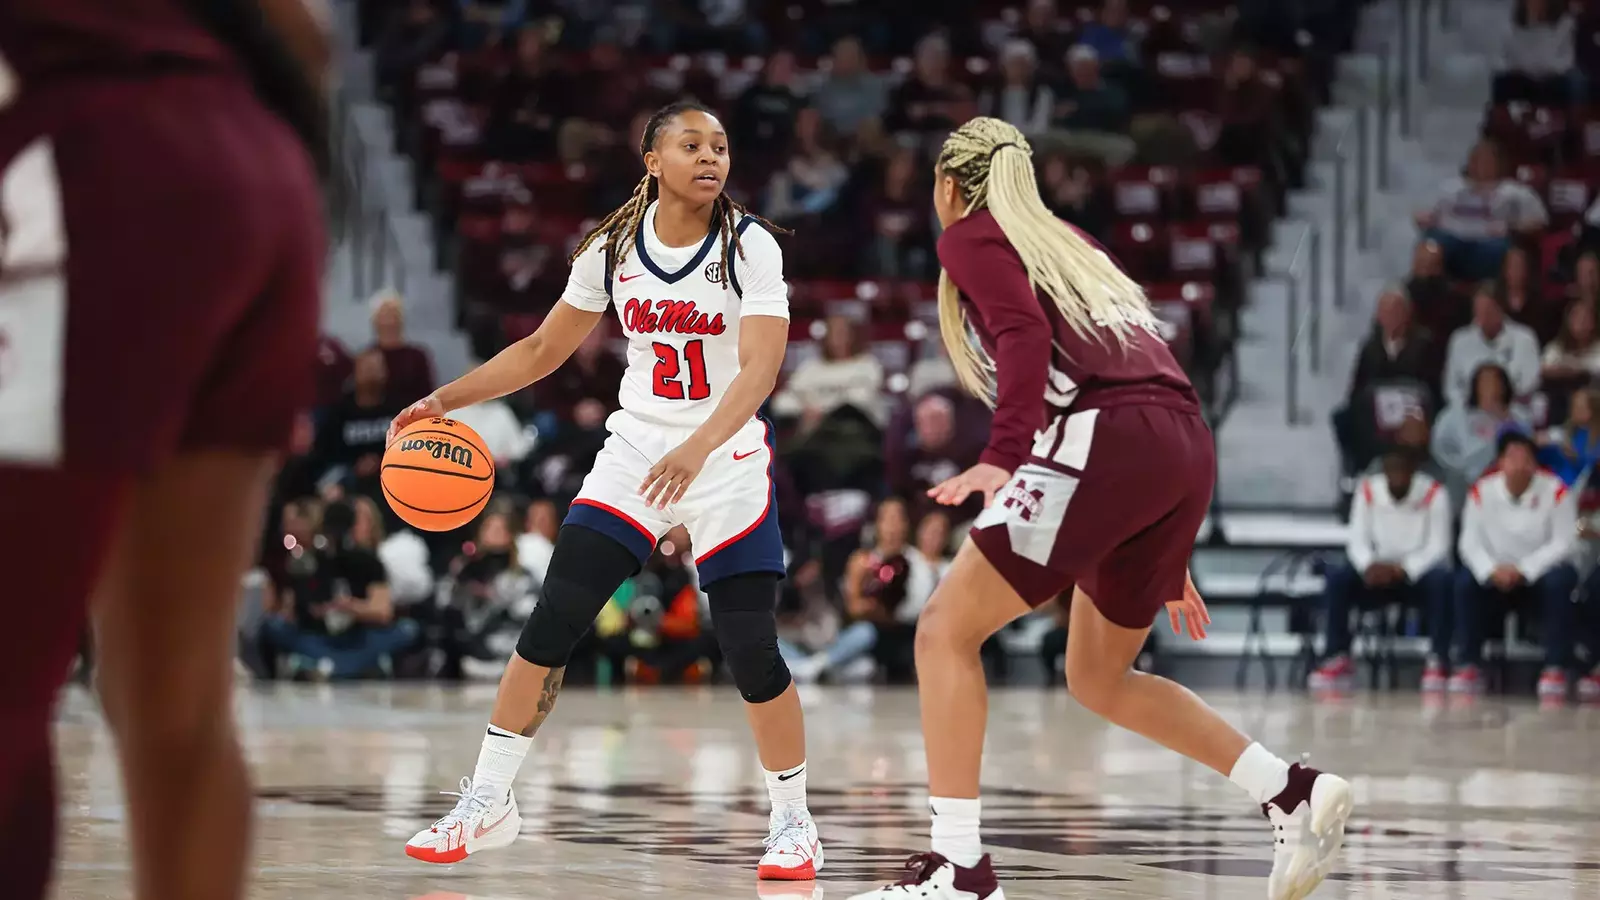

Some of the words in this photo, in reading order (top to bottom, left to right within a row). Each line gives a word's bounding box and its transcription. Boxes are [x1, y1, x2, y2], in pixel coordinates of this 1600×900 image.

[624, 298, 658, 334] Ole
[656, 299, 726, 335] Miss
[652, 339, 711, 400] 21
[401, 439, 473, 469] Wilson
